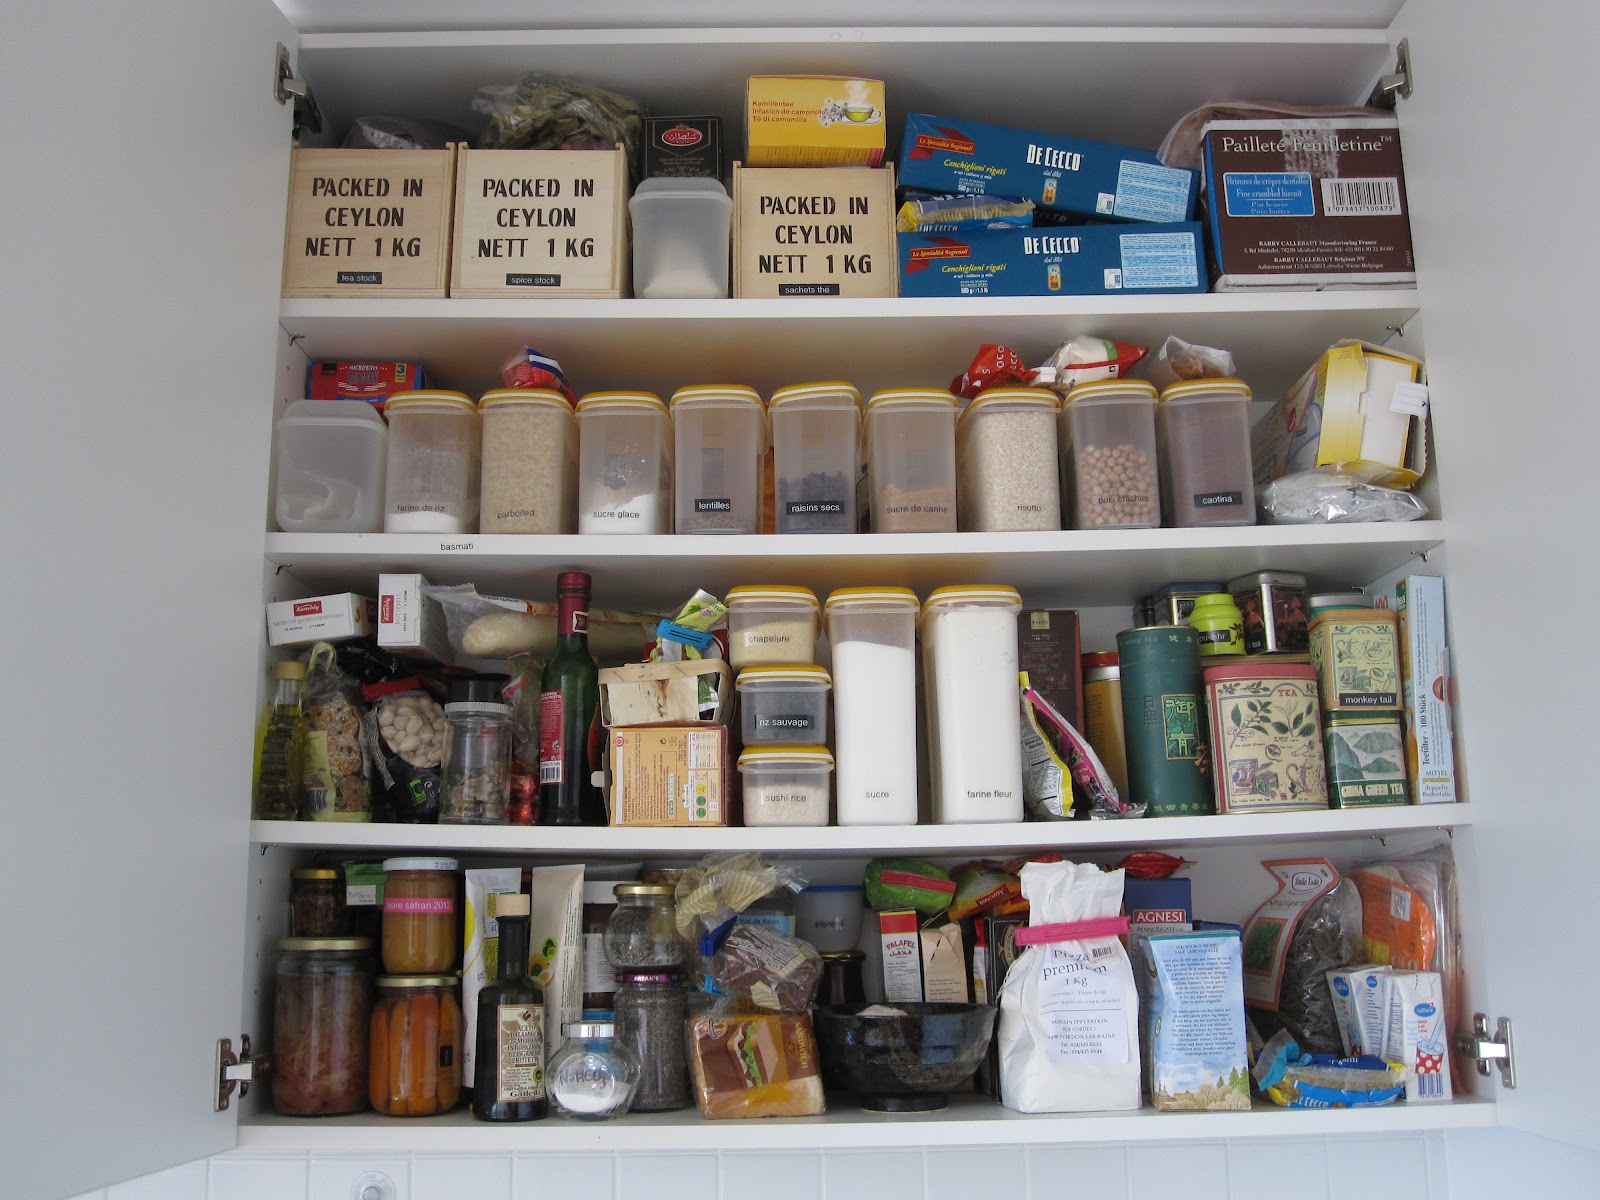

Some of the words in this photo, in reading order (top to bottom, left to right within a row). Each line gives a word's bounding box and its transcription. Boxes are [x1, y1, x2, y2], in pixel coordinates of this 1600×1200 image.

[1222, 136, 1286, 153] Pailleté
[1026, 143, 1042, 167] DE
[1046, 147, 1082, 172] CECCO
[943, 158, 986, 172] Conchiglioni
[986, 164, 1008, 176] rigati
[1253, 176, 1261, 185] de
[312, 177, 390, 198] PACKED
[402, 178, 424, 197] IN
[482, 178, 561, 198] PACKED
[574, 178, 594, 198] IN
[1236, 188, 1251, 197] Fine
[1251, 187, 1281, 197] crumbled
[1281, 188, 1303, 197] biscuit
[760, 196, 836, 215] PACKED
[849, 196, 869, 215] IN
[325, 207, 405, 227] CEYLON
[496, 207, 576, 228] CEYLON
[775, 224, 853, 244] CEYLON
[305, 237, 356, 257] NETT
[374, 238, 383, 257] 1
[392, 237, 421, 257] KG
[478, 237, 528, 258] NETT
[548, 238, 556, 258] 1
[565, 237, 594, 258] KG
[1023, 236, 1040, 255] DE
[1042, 236, 1080, 254] CECCO
[759, 254, 808, 274] NETT
[826, 254, 834, 274] 1
[844, 254, 872, 274] KG
[941, 263, 985, 274] Conchiglioni
[985, 263, 1008, 273] rigati
[341, 274, 355, 282] tea
[356, 273, 378, 282] stock
[511, 275, 533, 285] spice
[534, 275, 556, 285] stock
[785, 285, 815, 294] sachets
[816, 285, 830, 294] the
[396, 363, 406, 375] 3
[347, 372, 378, 385] POPCORN
[1098, 496, 1116, 505] pois
[1117, 494, 1149, 503] chiches
[1202, 495, 1233, 505] caotina
[397, 504, 421, 512] farine
[422, 504, 433, 512] de
[434, 504, 445, 513] riz
[699, 501, 730, 511] lentilles
[791, 503, 819, 513] raisins
[820, 504, 840, 512] secs
[886, 506, 909, 514] sucre
[911, 505, 922, 513] de
[923, 506, 948, 514] canne
[1017, 503, 1042, 513] risotto
[497, 508, 535, 519] parboiled
[617, 510, 640, 519] glace
[440, 542, 474, 551] basmati
[749, 635, 790, 645] chapelure
[1277, 689, 1298, 697] TEA
[1345, 695, 1378, 705] monkey
[1379, 695, 1393, 704] tail
[1419, 694, 1427, 713] Stück
[759, 717, 770, 727] riz
[771, 718, 809, 728] sauvage
[1420, 714, 1428, 729] 100
[1421, 733, 1430, 766] Teefilter
[765, 794, 789, 802] sushi
[790, 794, 807, 802] rice
[865, 790, 890, 798] sucre
[967, 790, 992, 798] farine
[993, 790, 1013, 798] fleur
[387, 902, 403, 911] poire
[404, 901, 432, 910] safran
[433, 901, 451, 910] 2012
[1136, 911, 1183, 923] AGNESI
[885, 939, 916, 951] FALAFEL
[1053, 949, 1090, 962] Piza
[1043, 962, 1108, 981] premim
[1073, 976, 1088, 987] Kg
[795, 1021, 809, 1069] SANDWICH
